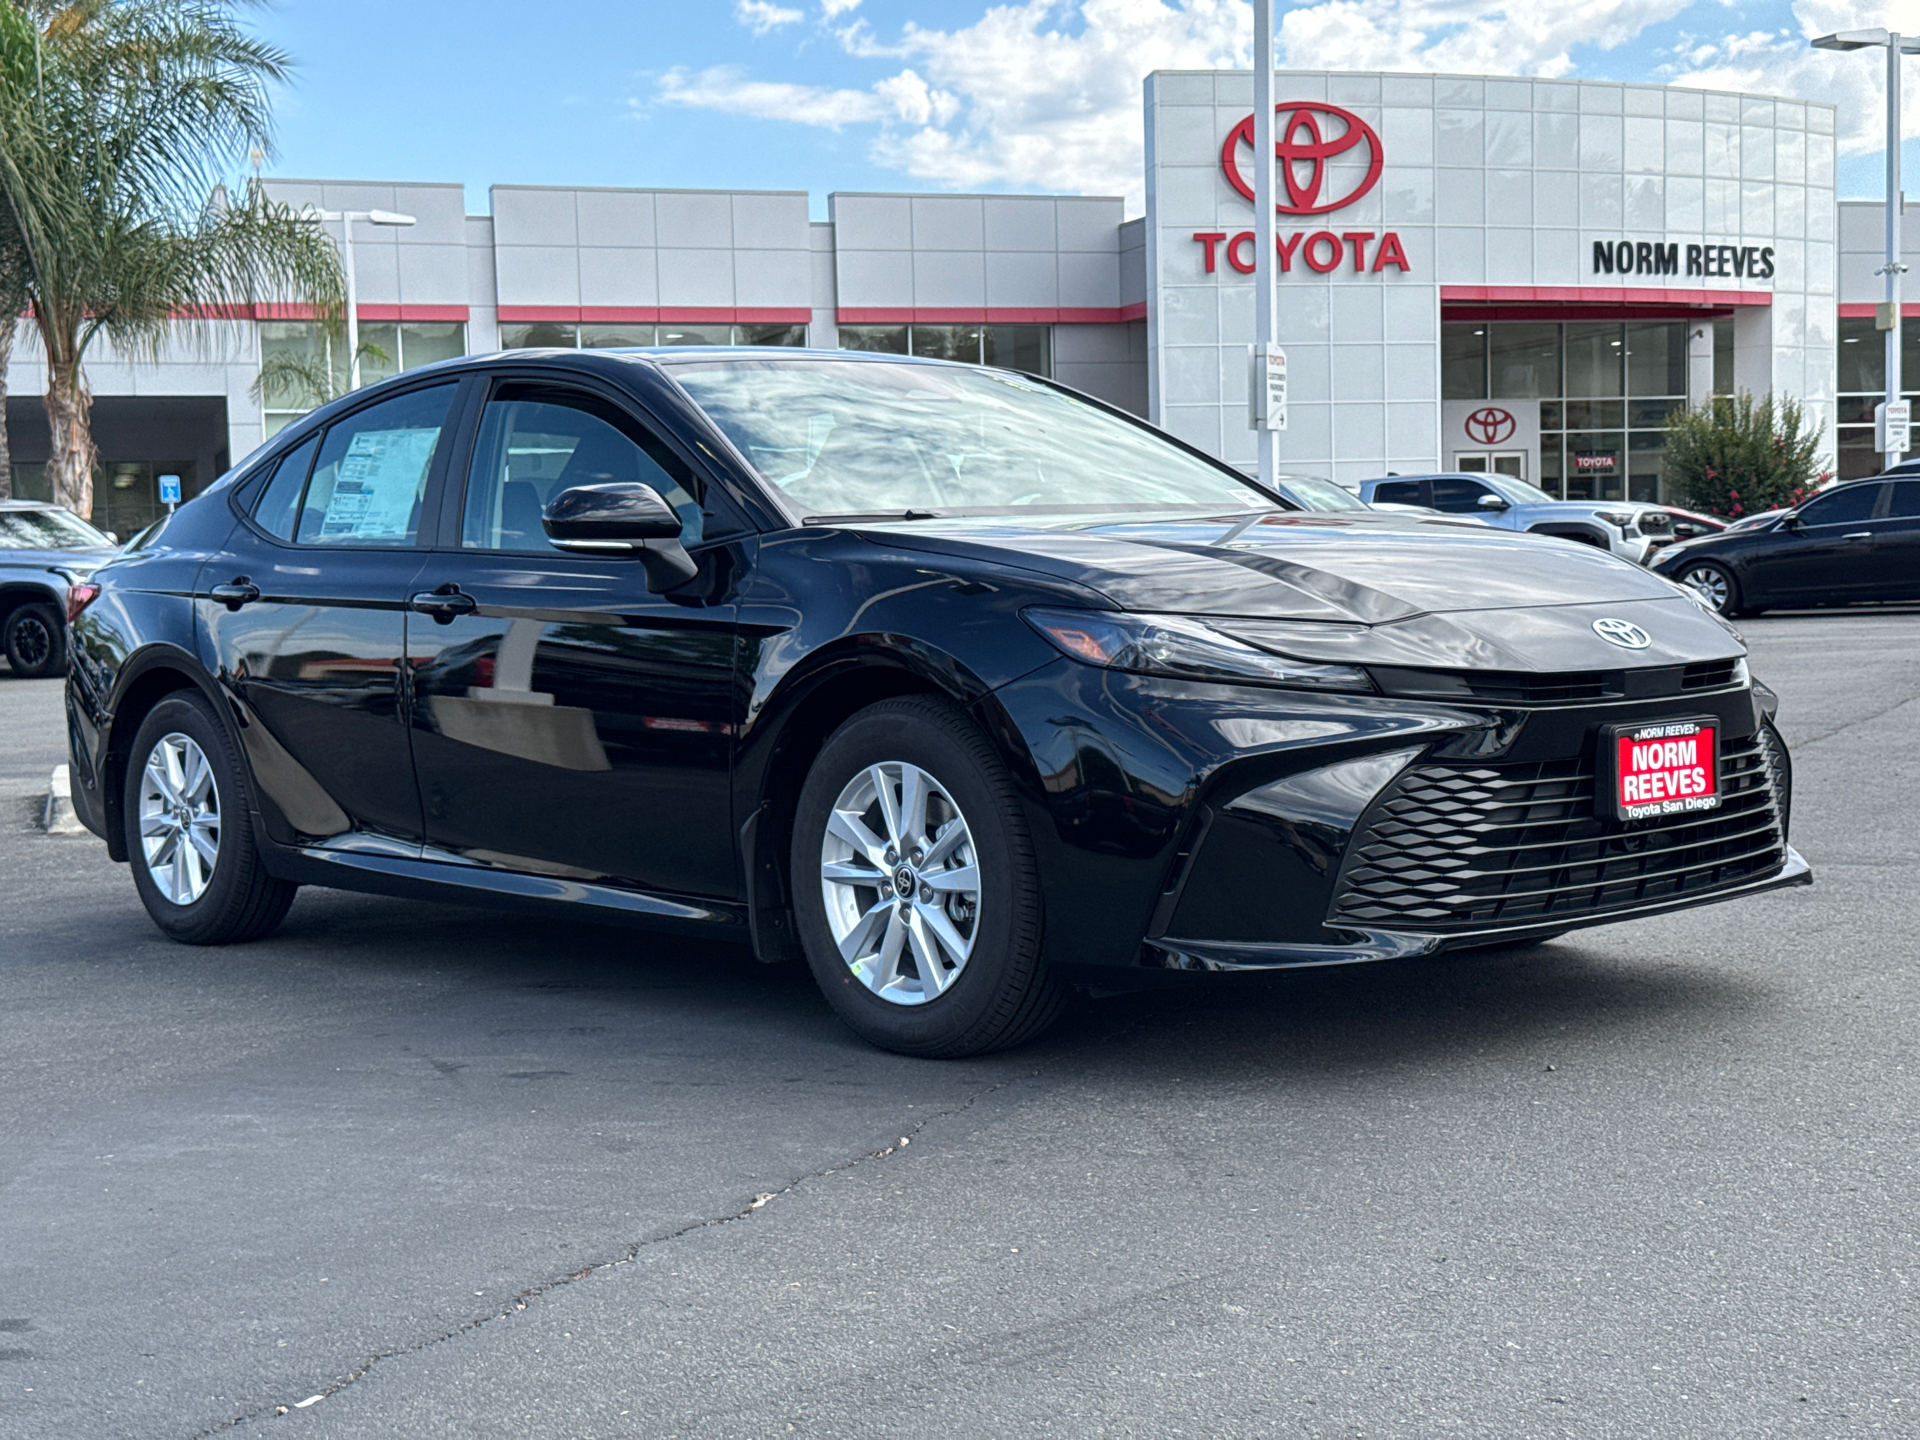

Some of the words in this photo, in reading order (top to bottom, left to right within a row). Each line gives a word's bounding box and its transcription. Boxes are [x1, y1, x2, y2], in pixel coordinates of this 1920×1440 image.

[1193, 231, 1411, 273] TOYOTA
[1593, 241, 1679, 275] NORM
[1686, 243, 1775, 280] REEVES
[1268, 354, 1285, 366] TOYOTA
[1577, 457, 1614, 467] TOYOTA
[1640, 727, 1664, 739] NORM
[1665, 724, 1694, 736] REEVES
[1632, 740, 1697, 772] NORM
[1624, 767, 1706, 802] REEVES
[1625, 804, 1660, 819] Toyota
[1662, 799, 1683, 813] San
[1685, 797, 1716, 810] Diego
